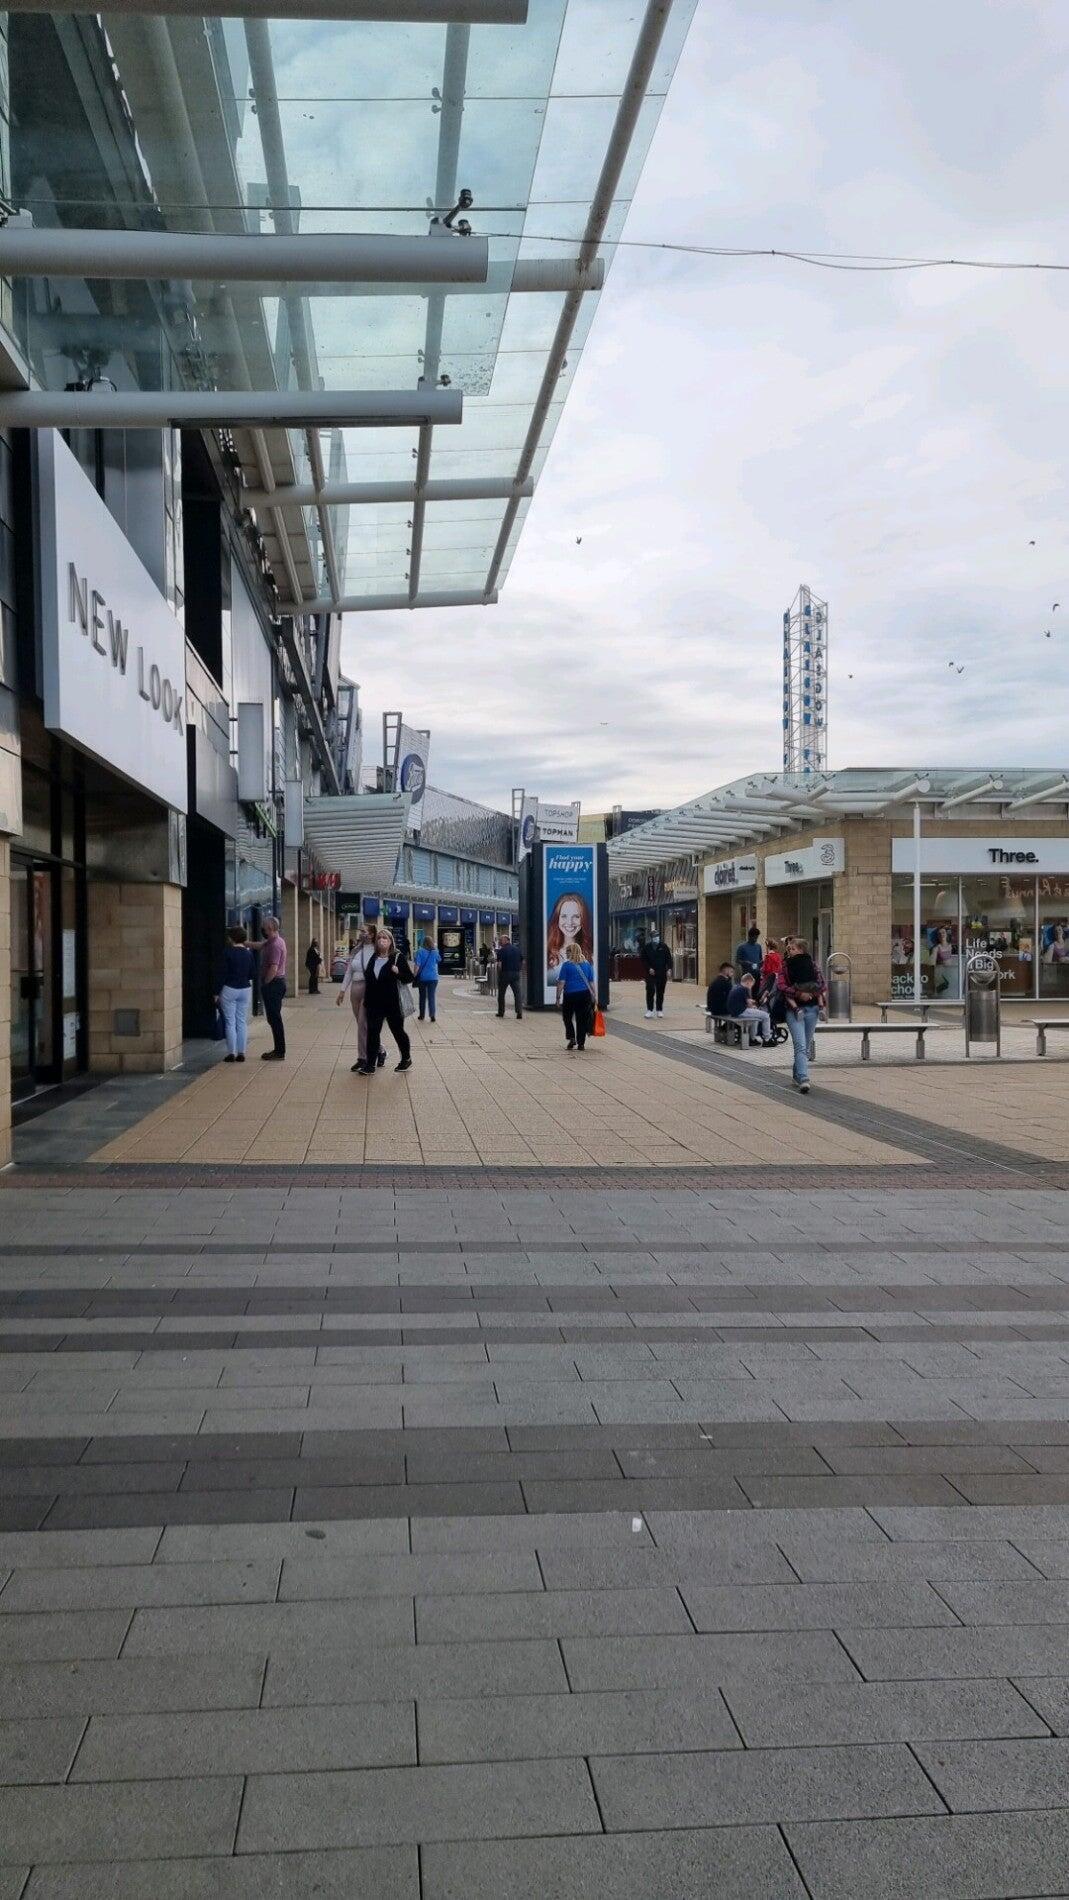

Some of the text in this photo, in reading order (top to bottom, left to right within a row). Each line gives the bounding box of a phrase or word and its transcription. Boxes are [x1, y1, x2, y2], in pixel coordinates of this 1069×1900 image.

[68, 561, 184, 737] NEW LOOK
[544, 808, 574, 818] TOPSHOP
[542, 827, 574, 837] TOPMAN
[548, 858, 592, 872] happy
[966, 938, 987, 949] Life
[975, 959, 994, 971] Big
[892, 973, 914, 984] ack
